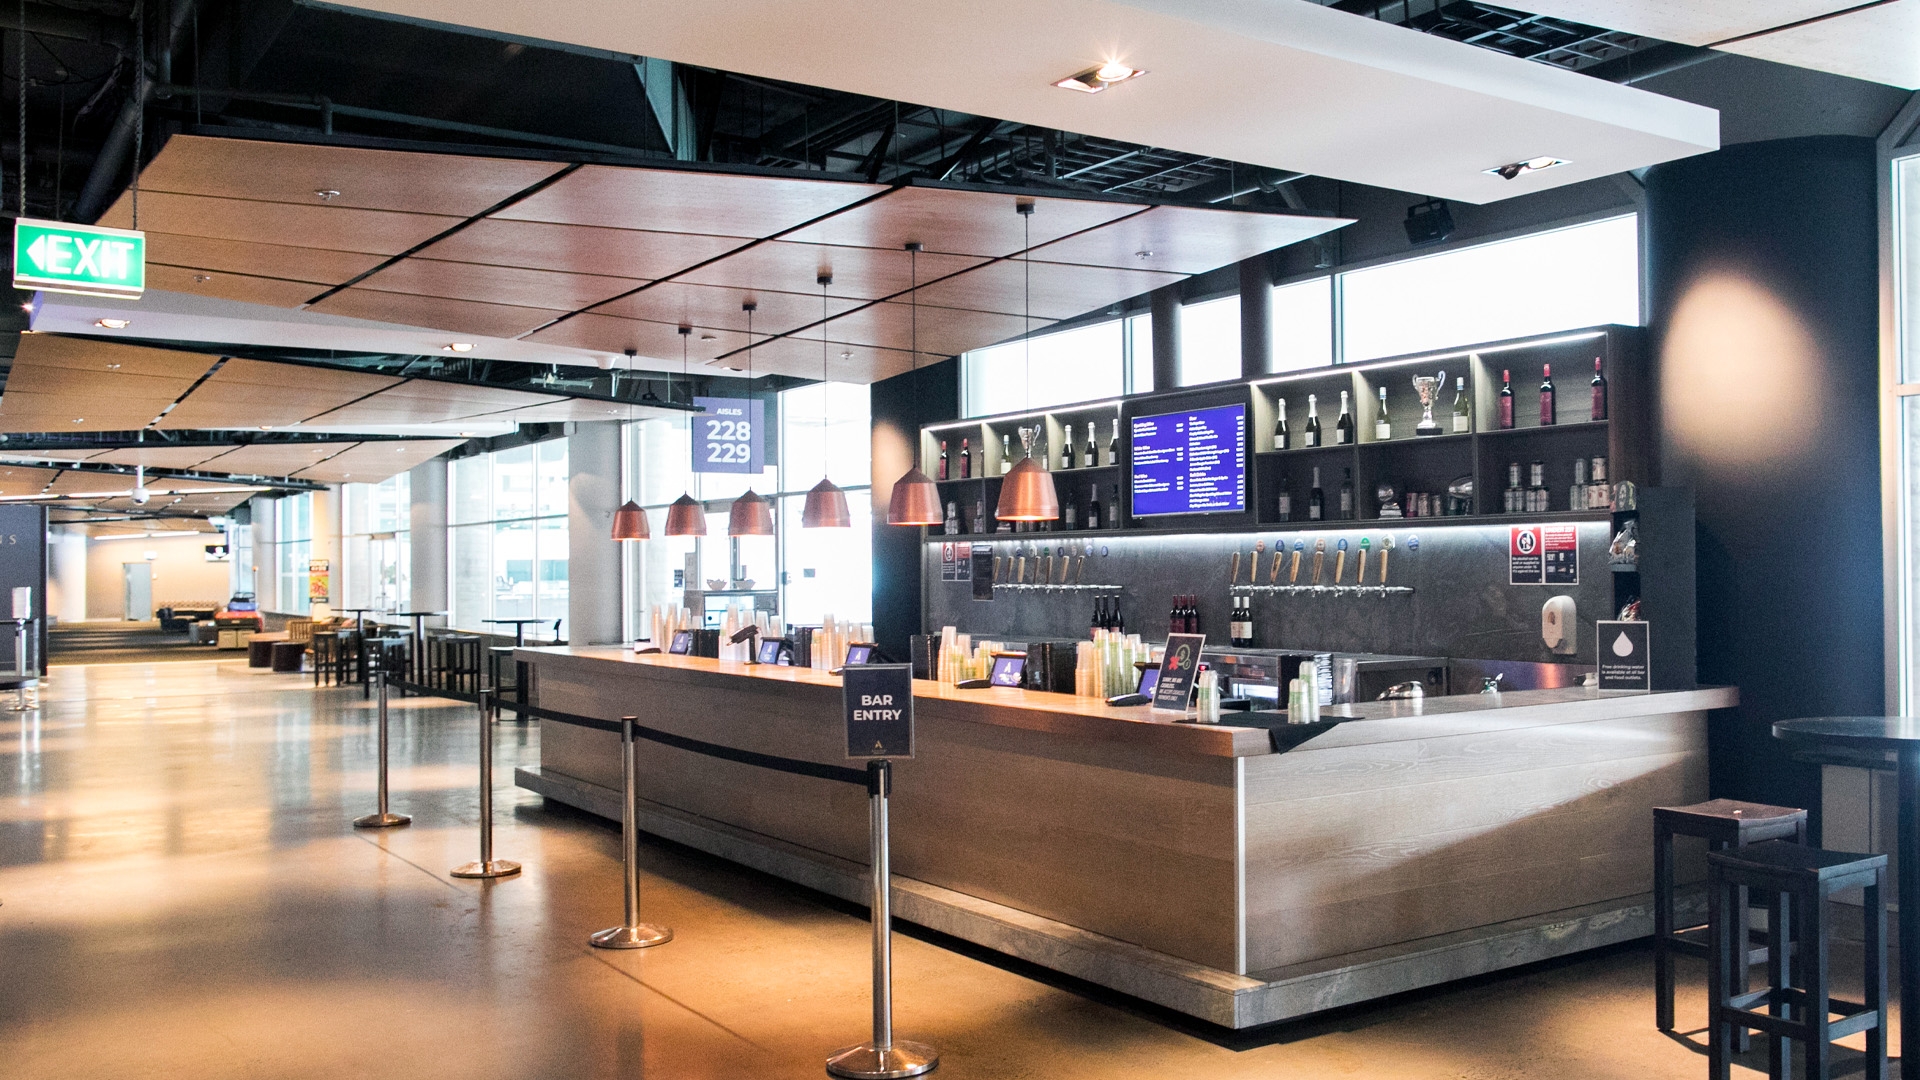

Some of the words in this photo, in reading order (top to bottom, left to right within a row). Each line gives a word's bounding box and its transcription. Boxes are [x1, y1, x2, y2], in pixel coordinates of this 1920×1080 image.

[46, 234, 134, 280] EXIT
[716, 407, 742, 416] AISLES
[706, 420, 750, 442] 228
[706, 442, 750, 464] 229
[862, 695, 892, 706] BAR
[854, 710, 902, 720] ENTRY
